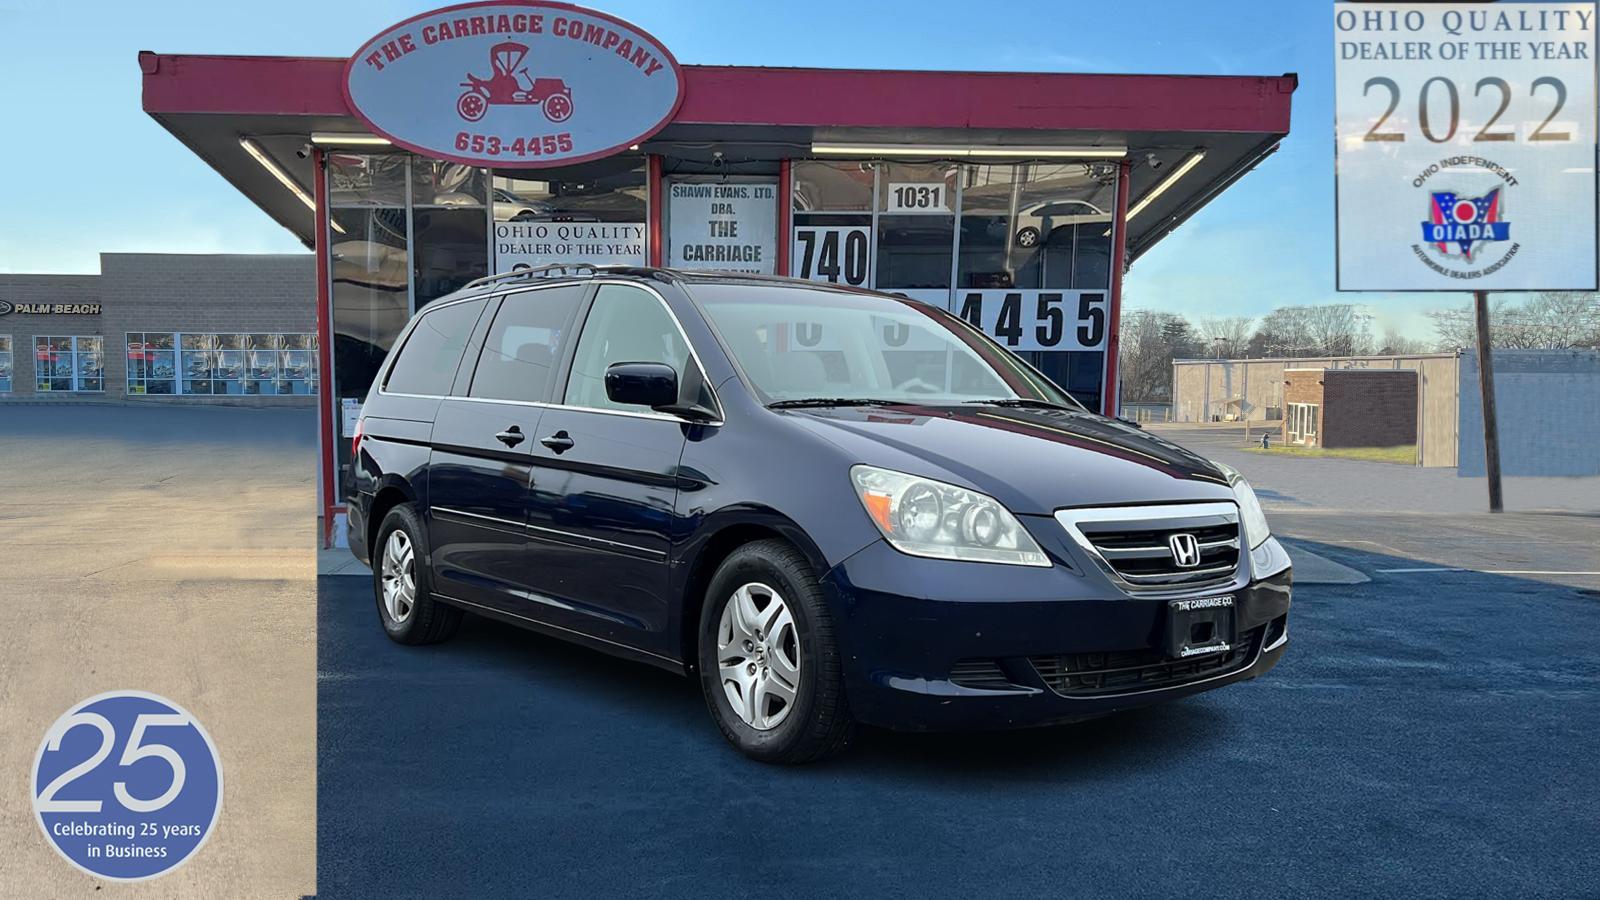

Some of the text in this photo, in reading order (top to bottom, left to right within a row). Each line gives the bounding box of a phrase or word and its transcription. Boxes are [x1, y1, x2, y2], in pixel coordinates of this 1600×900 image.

[1336, 10, 1592, 36] OHIO QUALITY
[365, 14, 664, 77] THE CARRIAGE COMPANY
[1340, 41, 1589, 60] DEALER OF THE YEAR
[1363, 76, 1571, 143] 2022
[455, 132, 573, 156] 653-4455
[1412, 155, 1519, 188] OHIO INDEPENDENT
[673, 186, 711, 198] SHAWN
[754, 187, 774, 199] LTD.
[894, 187, 940, 208] 1031
[711, 203, 736, 215] DBA.
[497, 226, 644, 241] OHIO QUALITY
[709, 220, 737, 237] THE
[1433, 224, 1495, 240] OIADA
[500, 244, 641, 255] DEALER OF THE YEAR
[683, 244, 762, 262] CARRIAGE
[798, 230, 868, 286] 740
[1411, 242, 1520, 279] AUTOMOBILE DEALERS ASSOCIATION
[15, 304, 99, 314] PALM BEACH
[1178, 601, 1190, 611] THE
[1191, 598, 1221, 609] CARRIAGE
